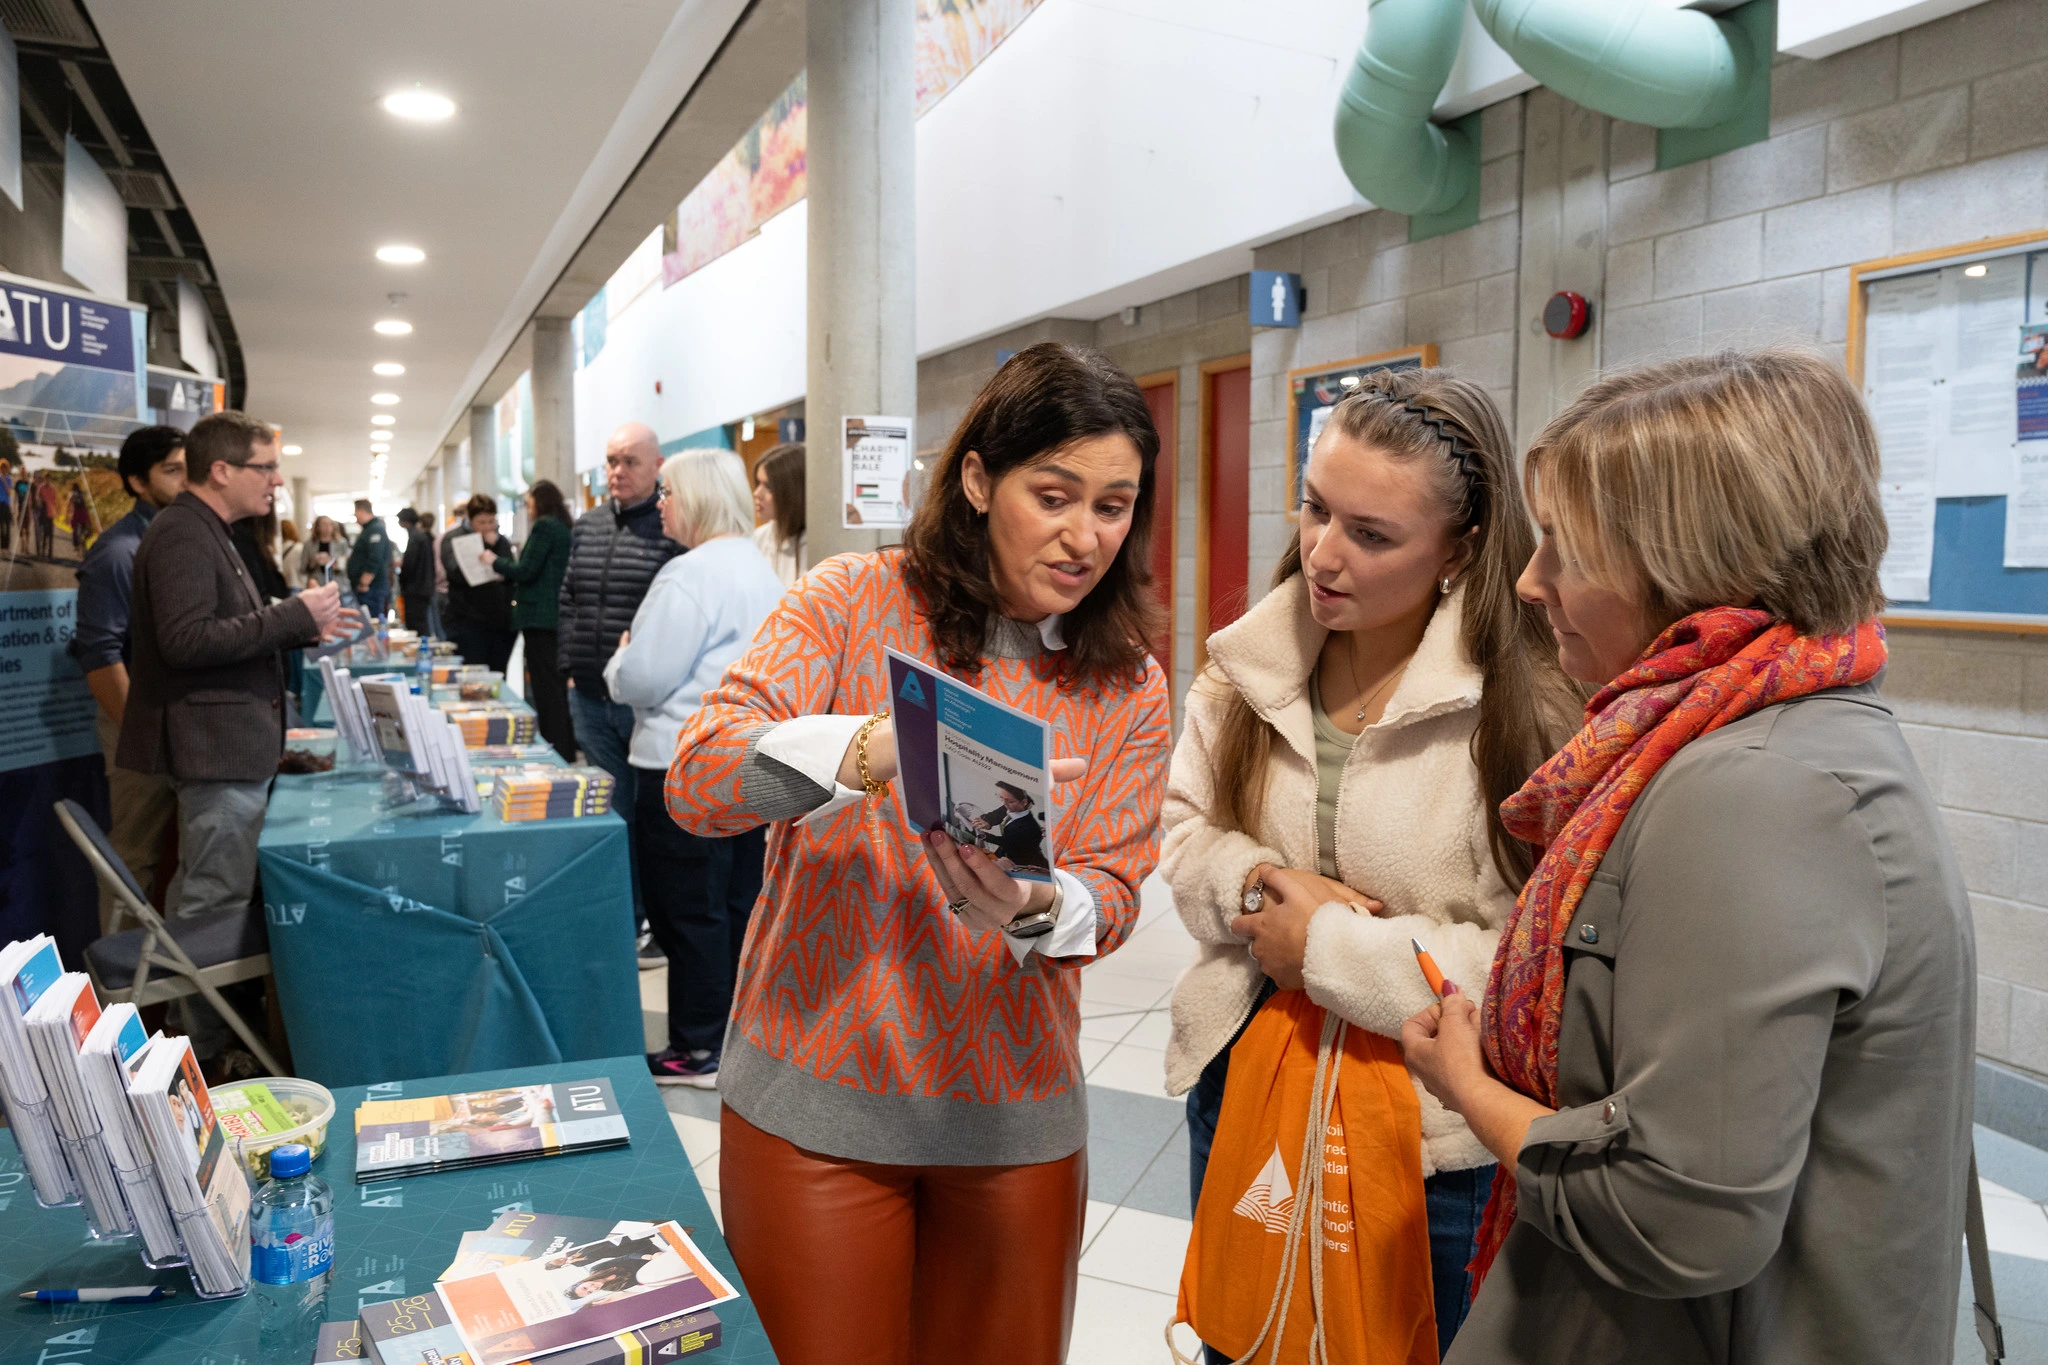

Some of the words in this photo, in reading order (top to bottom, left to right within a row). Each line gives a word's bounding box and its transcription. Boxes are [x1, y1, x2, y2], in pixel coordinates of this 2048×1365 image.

[854, 454, 883, 462] BAKE
[855, 444, 899, 453] CHARITY
[854, 463, 881, 471] SALE
[57, 600, 72, 619] of
[44, 625, 56, 644] &
[944, 734, 986, 761] Hospitality
[985, 755, 1040, 784] Management
[568, 1085, 607, 1111] ATU
[219, 1113, 254, 1139] HARIBO
[361, 1179, 403, 1208] AT
[502, 1213, 536, 1237] ATU
[336, 1337, 362, 1358] 25
